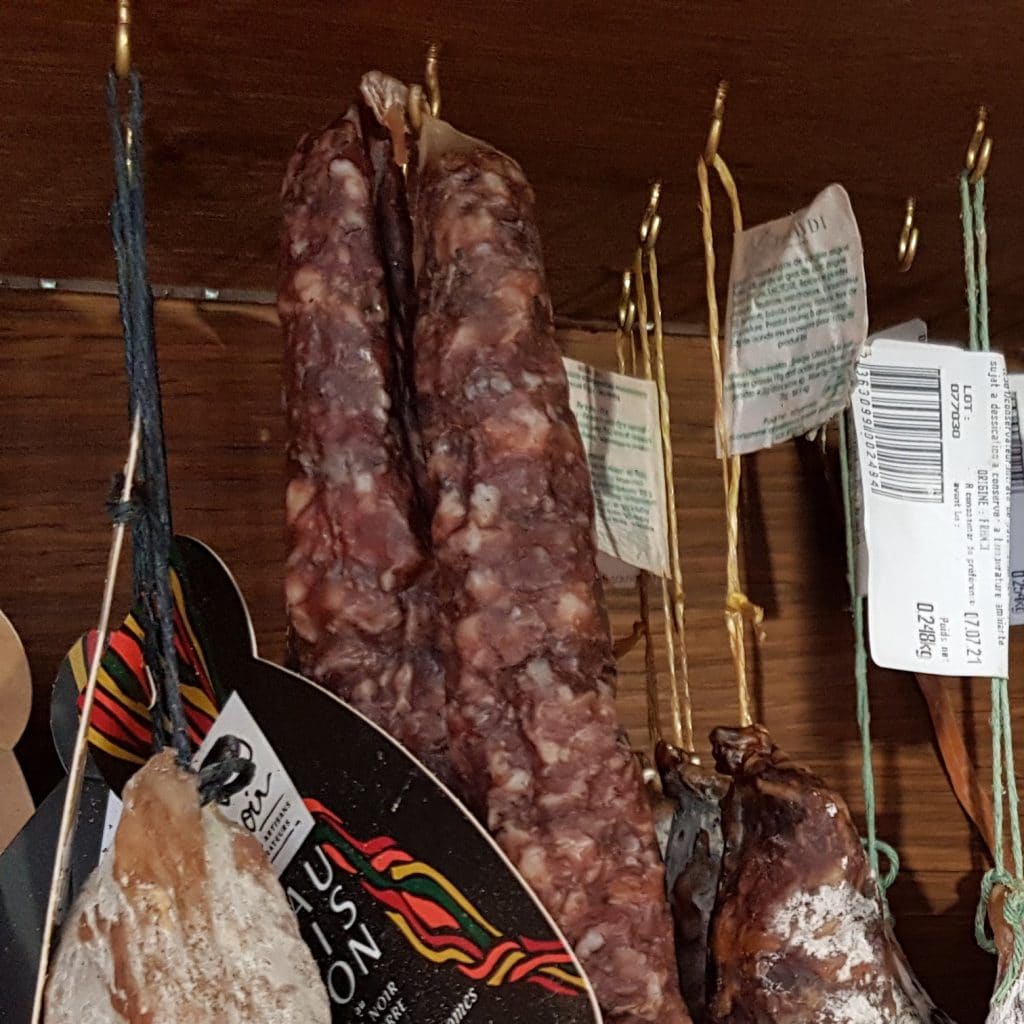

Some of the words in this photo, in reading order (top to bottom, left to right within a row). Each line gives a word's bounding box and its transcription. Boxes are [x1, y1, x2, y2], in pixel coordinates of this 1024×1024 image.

[964, 385, 973, 413] LOT
[327, 922, 382, 1004] ON
[368, 980, 399, 1022] NOIR
